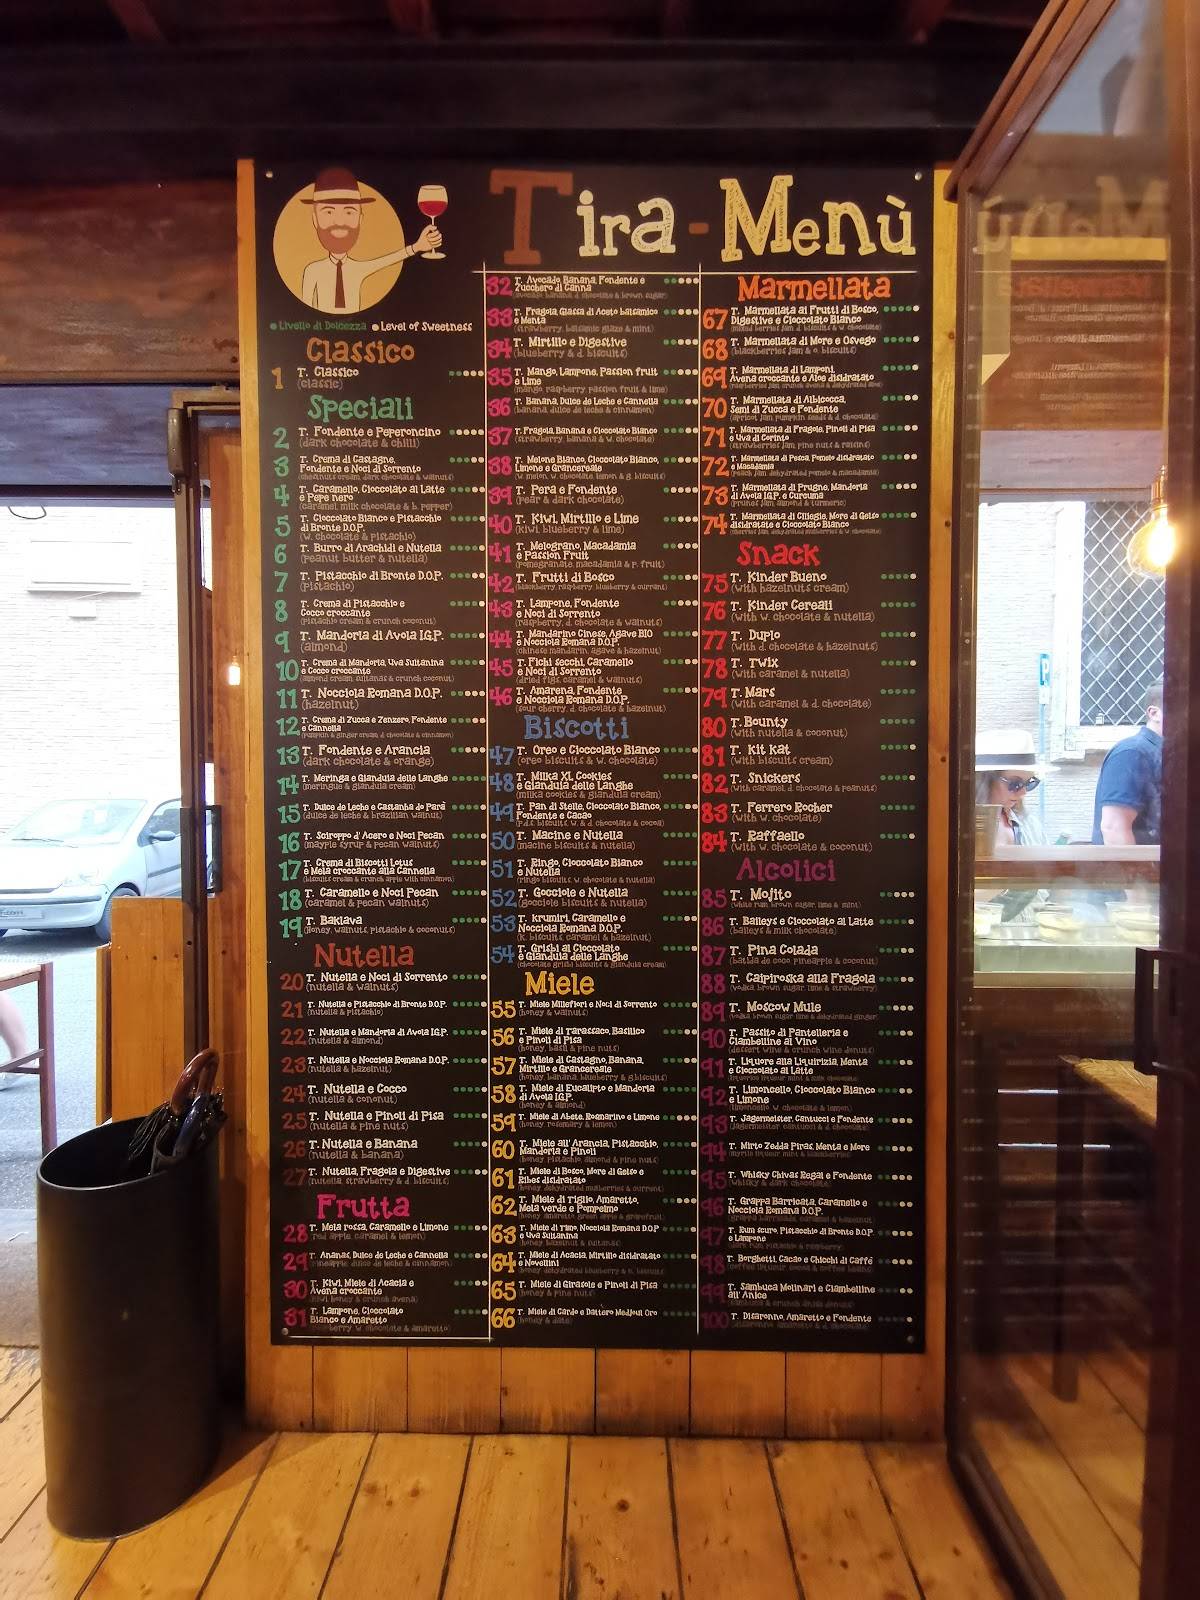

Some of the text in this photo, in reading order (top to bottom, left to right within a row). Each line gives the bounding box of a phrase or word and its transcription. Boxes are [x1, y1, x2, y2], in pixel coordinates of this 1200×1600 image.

[490, 170, 676, 265] Tira
[719, 174, 916, 262] Menù
[738, 275, 892, 302] Marmellata
[744, 305, 796, 315] Marmellata
[798, 305, 808, 315] ai
[809, 305, 839, 315] Frutti
[841, 305, 850, 315] di
[702, 308, 729, 330] 67
[279, 322, 367, 332] Livello di Dolcezza
[381, 322, 472, 332] Level of Sweetness
[487, 337, 511, 359] 34
[528, 336, 567, 349] Mirtillo
[569, 339, 576, 347] e
[578, 336, 627, 349] Digestive
[306, 337, 415, 364] Classico
[271, 367, 284, 390] 1
[314, 367, 359, 377] Classico
[307, 394, 414, 423] Speciali
[273, 427, 290, 449] 2
[313, 426, 365, 438] Fondente
[366, 429, 374, 437] e
[376, 427, 441, 438] Peperoncino
[329, 437, 378, 449] chocolate
[380, 438, 389, 448] &
[391, 437, 420, 449] chilli)
[488, 485, 513, 505] 39
[531, 485, 556, 495] Pera
[559, 487, 565, 495] e
[567, 485, 618, 495] Fondente
[274, 544, 287, 564] 6
[313, 543, 343, 554] Burro
[344, 543, 353, 554] di
[355, 543, 396, 554] Arachidi
[398, 545, 404, 553] e
[406, 543, 442, 554] Nutella
[736, 540, 821, 567] Snack
[274, 570, 289, 593] 7
[315, 570, 367, 582] Pistacchio
[369, 570, 379, 582] di
[381, 570, 416, 582] Bronte
[487, 573, 515, 593] 42
[532, 571, 568, 583] Frutti
[571, 571, 582, 583] di
[584, 571, 615, 583] Bosco
[702, 573, 729, 593] 75
[747, 570, 788, 583] Kinder
[789, 570, 827, 583] Bueno
[703, 600, 726, 621] 76
[747, 600, 788, 611] Kinder
[791, 600, 833, 611] Cereali
[748, 657, 779, 668] Twix
[276, 688, 298, 710] 11
[317, 688, 365, 699] Nocciola
[367, 688, 412, 699] Romana
[744, 686, 776, 699] Mars
[523, 715, 629, 740] Biscotti
[318, 745, 372, 756] Fondente
[384, 745, 430, 756] Arancia
[489, 745, 515, 765] 47
[533, 745, 557, 755] Oreo
[560, 747, 566, 755] e
[568, 745, 622, 755] Cioccolato
[623, 745, 660, 755] Bianco
[747, 772, 801, 784] Snickers
[747, 801, 792, 813] Ferrero
[794, 801, 833, 813] Rocher
[701, 830, 728, 853] 84
[747, 830, 805, 842] Raffaello
[736, 857, 836, 882] Alcolici
[278, 888, 303, 911] 18
[319, 887, 370, 898] Caramello
[381, 887, 404, 898] Noci
[406, 887, 439, 898] Pecan
[533, 887, 577, 898] Gocciole
[588, 887, 629, 898] Nutella
[750, 888, 792, 902] Mojito
[320, 915, 363, 926] Baklava
[313, 943, 415, 969] Nutella
[747, 944, 776, 956] Pina
[779, 944, 818, 956] Colada
[280, 973, 304, 991] 20
[321, 972, 357, 983] Nutella
[360, 974, 366, 982] e
[368, 972, 391, 983] Noci
[393, 972, 403, 983] di
[404, 972, 448, 983] Sorrento
[525, 970, 595, 996] Miele
[490, 1000, 516, 1018] 55
[701, 1001, 726, 1023] 89
[746, 1001, 790, 1013] Moscow
[793, 1001, 821, 1013] Mule
[490, 1027, 515, 1046] 56
[531, 1027, 553, 1036] Miele
[555, 1027, 564, 1036] di
[611, 1027, 645, 1036] Basilico
[324, 1084, 365, 1095] Nutella
[376, 1084, 407, 1095] Cocco
[794, 1085, 841, 1095] Cioccolato
[842, 1085, 875, 1095] Bianco
[316, 1193, 410, 1220] Frutta
[490, 1280, 516, 1301] 65
[491, 1307, 516, 1329] 66
